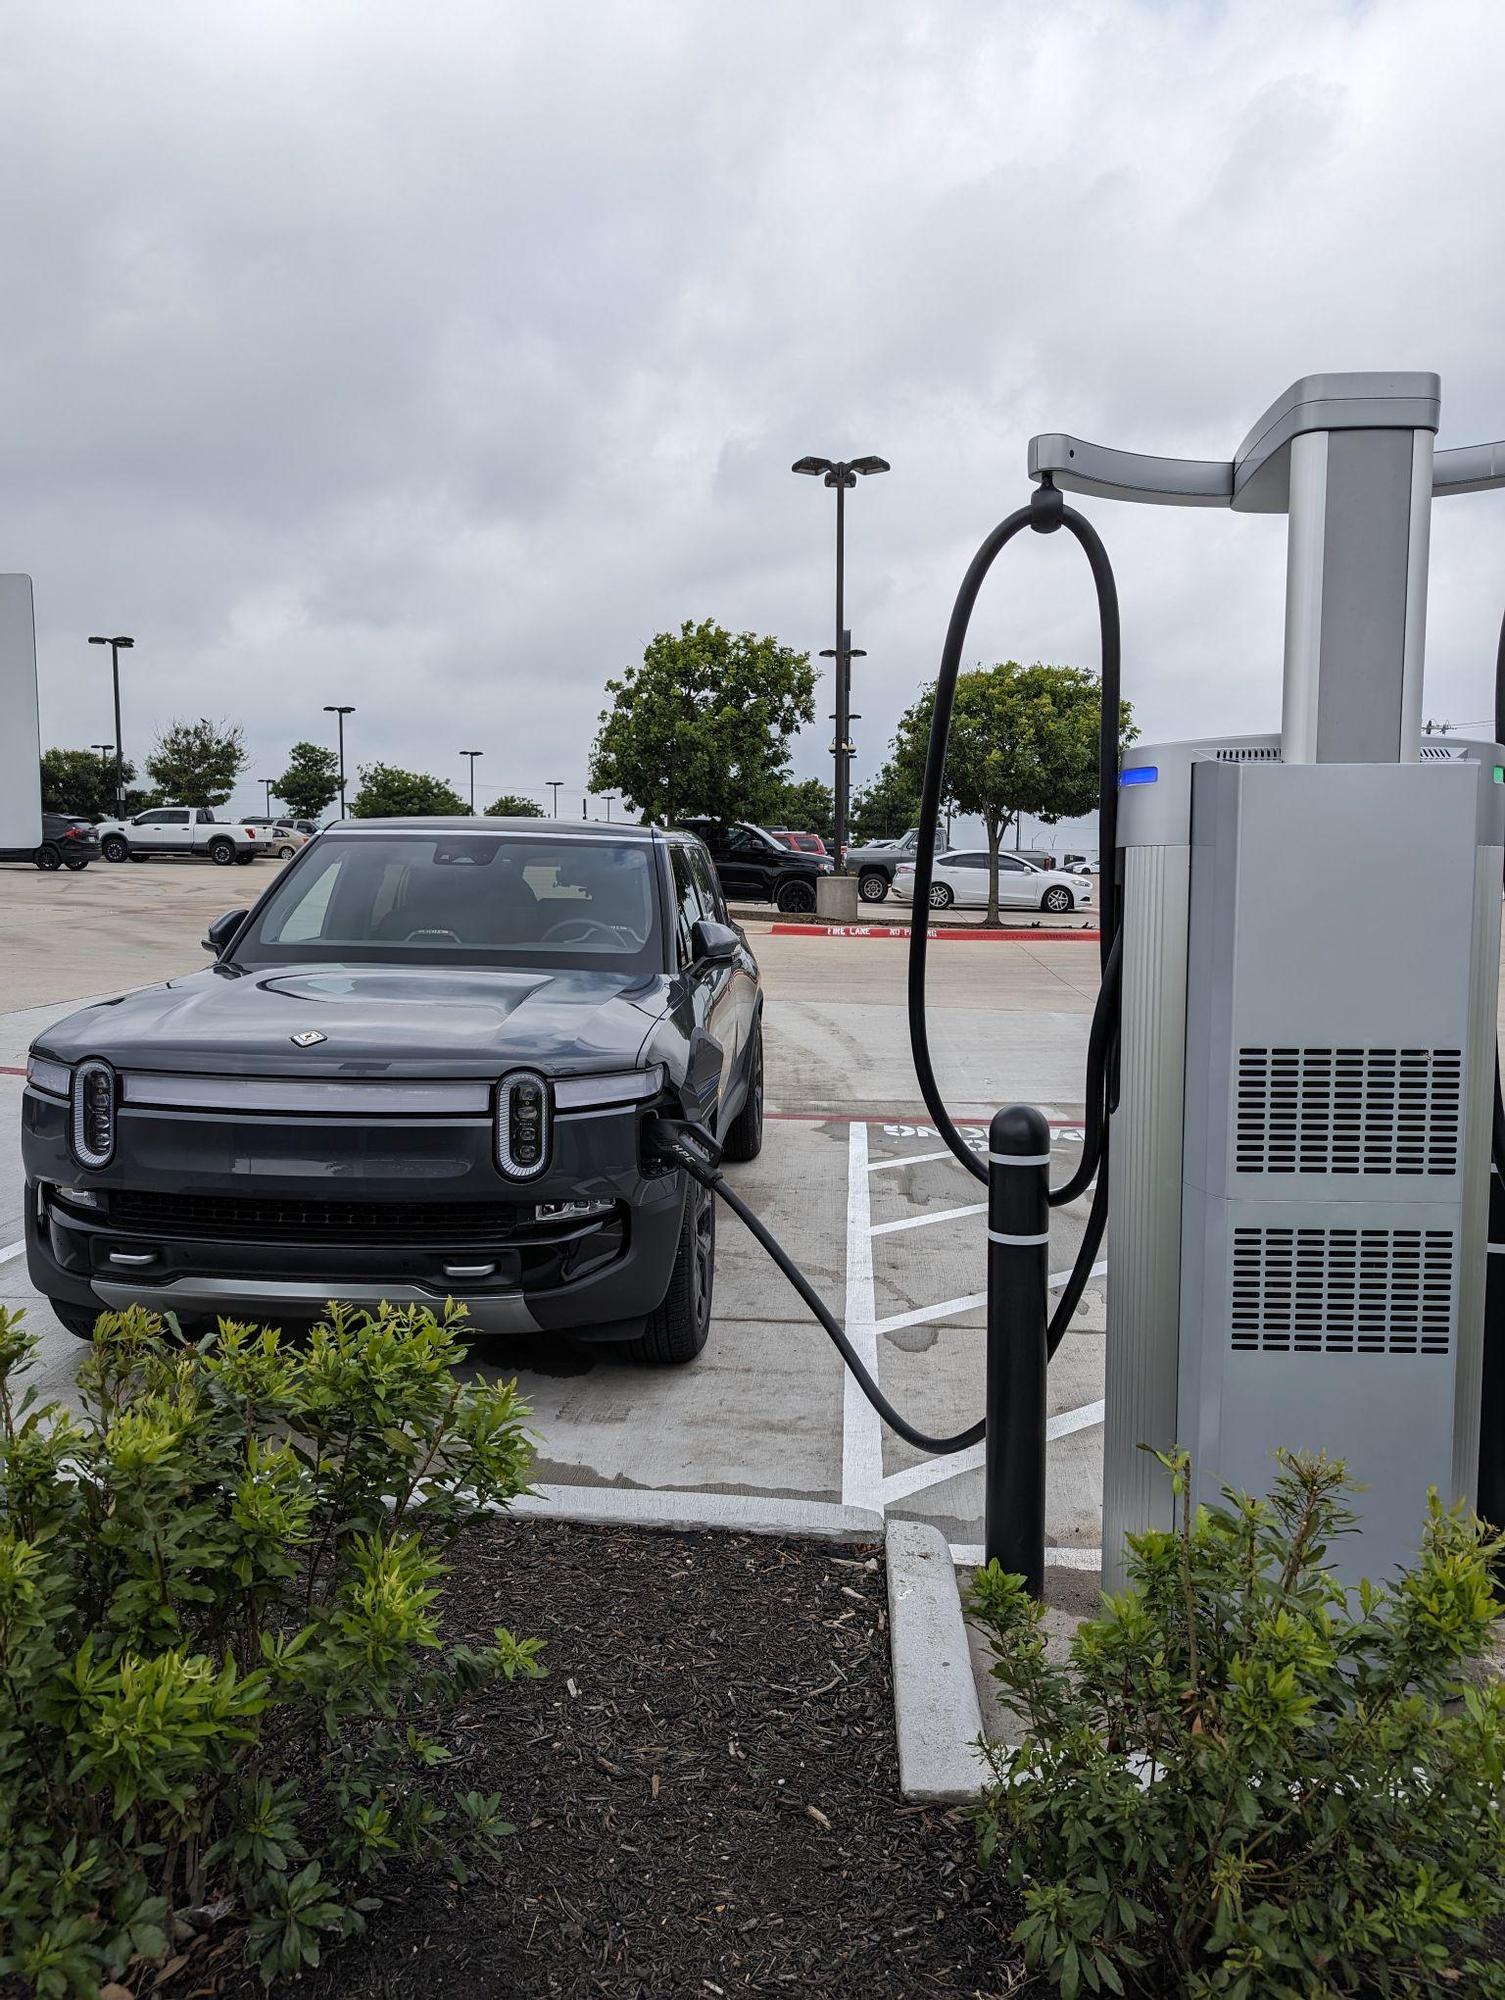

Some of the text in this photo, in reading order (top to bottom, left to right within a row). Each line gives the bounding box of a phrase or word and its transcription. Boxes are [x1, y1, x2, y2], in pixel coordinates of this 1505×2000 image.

[827, 927, 846, 936] FIRE
[849, 927, 871, 936] LANE
[889, 928, 901, 936] NO
[883, 1125, 1086, 1141] PKNG
[672, 1144, 696, 1163] HPC
